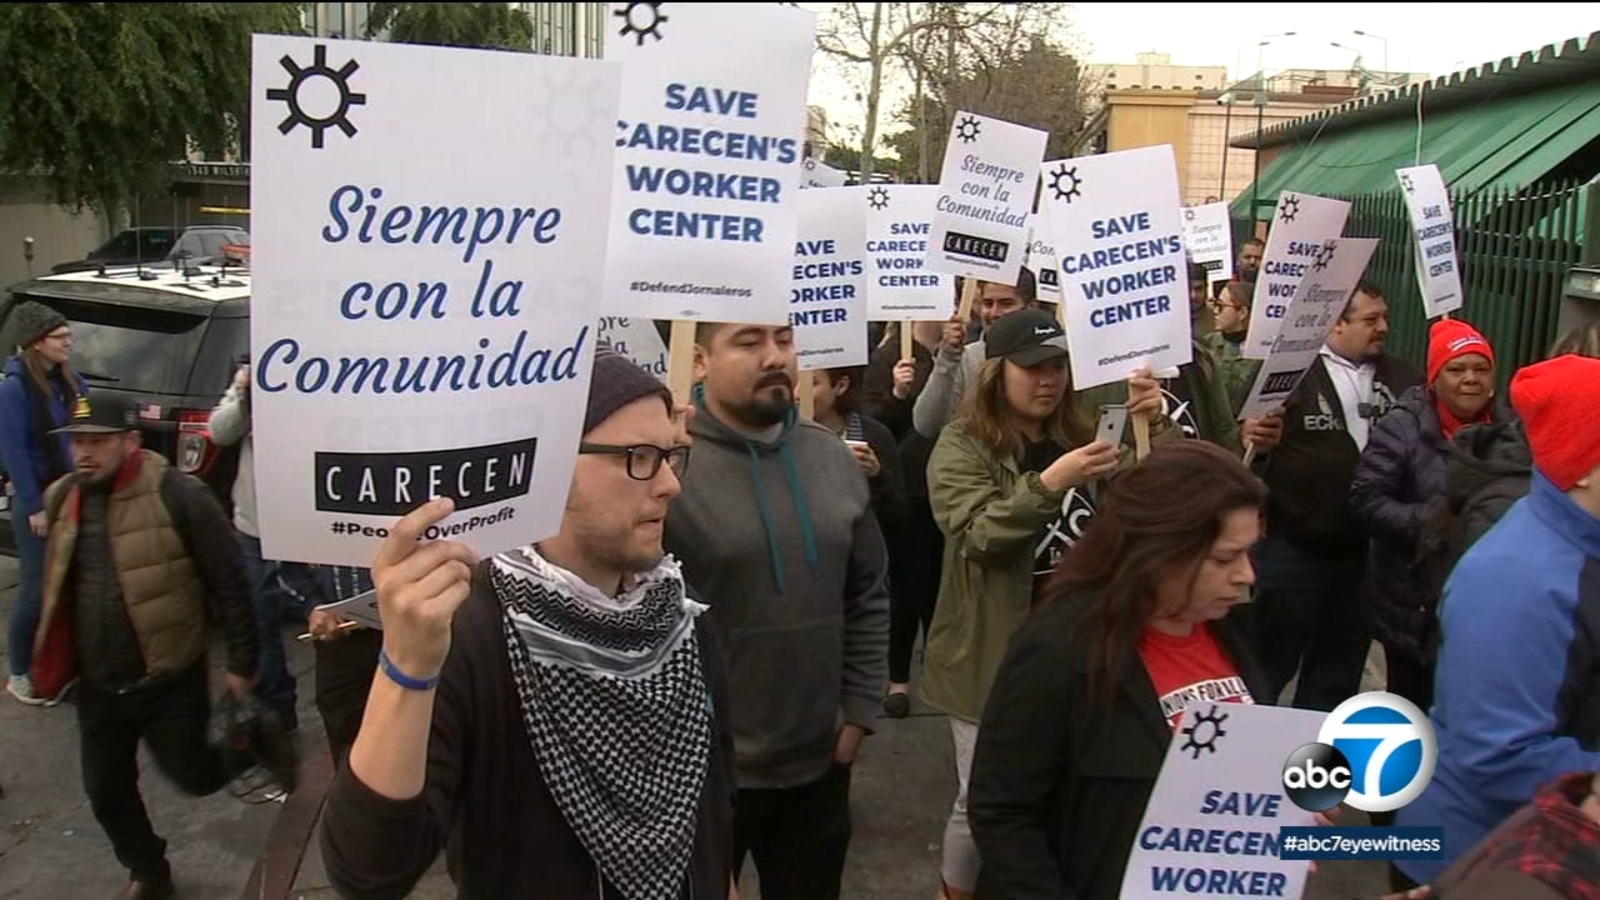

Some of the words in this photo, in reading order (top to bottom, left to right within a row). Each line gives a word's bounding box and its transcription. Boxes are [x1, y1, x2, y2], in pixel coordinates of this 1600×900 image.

[665, 83, 759, 118] SAVE
[615, 120, 796, 164] ARECEN'S
[625, 165, 782, 203] WORKER
[961, 154, 1025, 183] Siempre
[961, 182, 989, 198] con
[994, 184, 1011, 203] la
[322, 185, 561, 263] Siempre
[628, 208, 764, 242] CENTER
[936, 195, 1028, 228] Comunidad
[1092, 212, 1150, 239] SAVE
[890, 223, 931, 235] SAVE
[794, 240, 836, 257] AVE
[866, 241, 926, 252] CARECE
[1062, 235, 1181, 274] CARECEN'S
[793, 260, 863, 280] ECEN'S
[879, 275, 939, 287] CENTER
[1081, 265, 1176, 300] WORKER
[339, 281, 447, 319] con
[470, 259, 524, 318] la
[630, 281, 752, 298] #DefendJornaleros
[789, 308, 847, 327] NTER
[1090, 295, 1170, 328] CENTER
[256, 325, 589, 394] Comunidad
[326, 452, 527, 503] CARECEN
[331, 507, 515, 541] #PeoOverProfit
[1201, 790, 1281, 817] SAVE
[1140, 826, 1280, 856] CARECEN
[1152, 866, 1287, 896] WORKER
